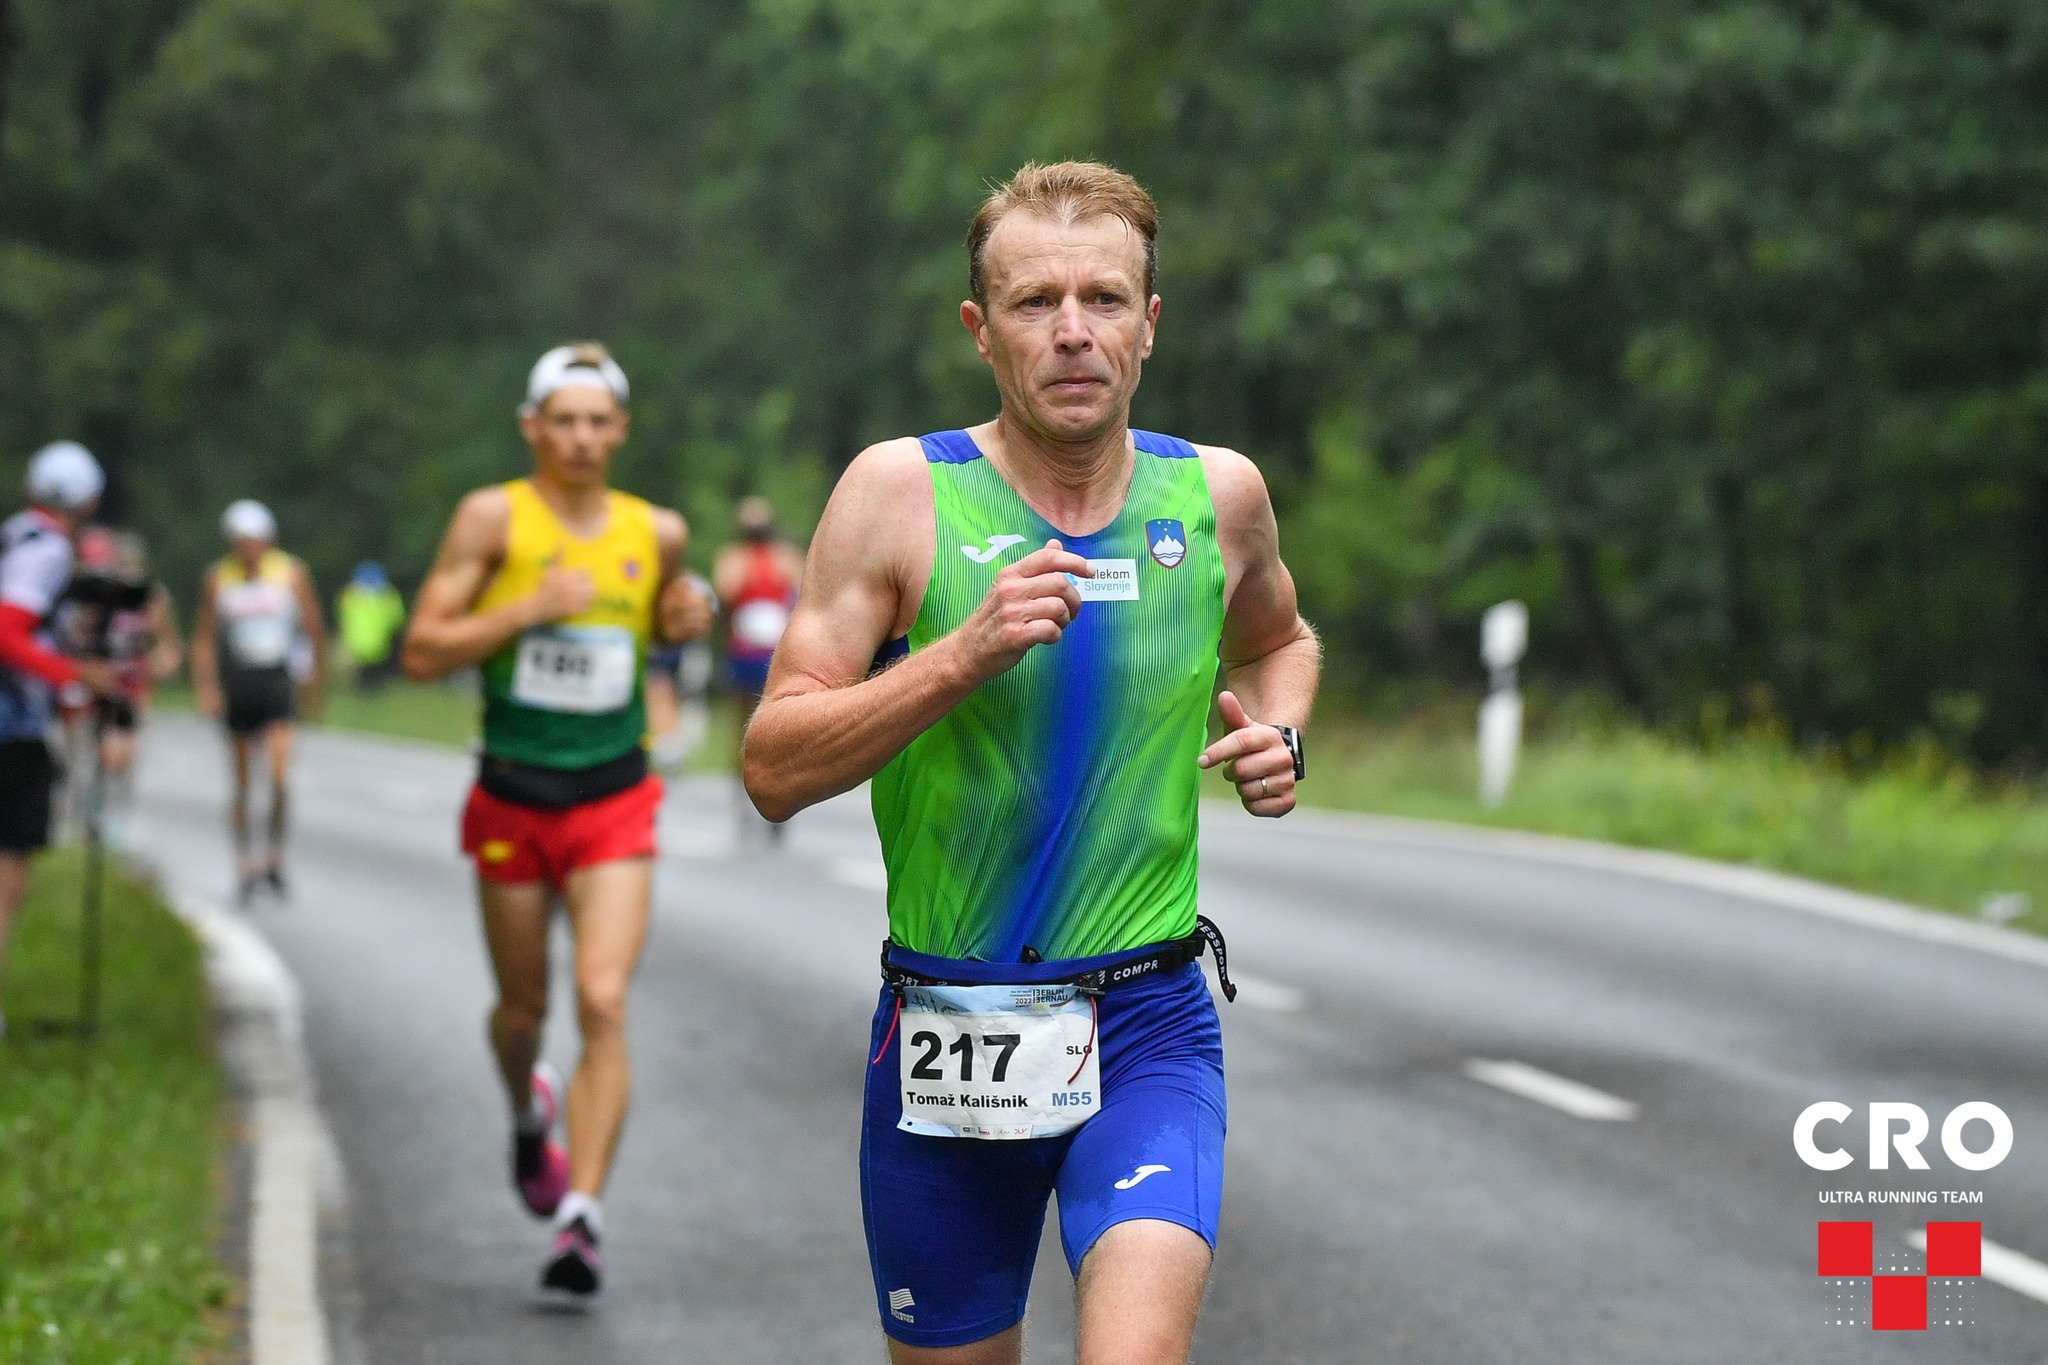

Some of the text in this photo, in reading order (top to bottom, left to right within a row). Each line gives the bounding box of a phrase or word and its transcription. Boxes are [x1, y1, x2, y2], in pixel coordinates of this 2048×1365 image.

[1091, 569, 1130, 579] lekom
[1085, 581, 1131, 593] Slovenije
[1032, 988, 1064, 997] BERLIN
[1032, 994, 1068, 1004] BERNAU
[1066, 1045, 1093, 1055] SLO
[910, 1031, 1021, 1082] 217
[906, 1092, 1029, 1108] Tomaž Kališnik
[1052, 1091, 1092, 1106] M55
